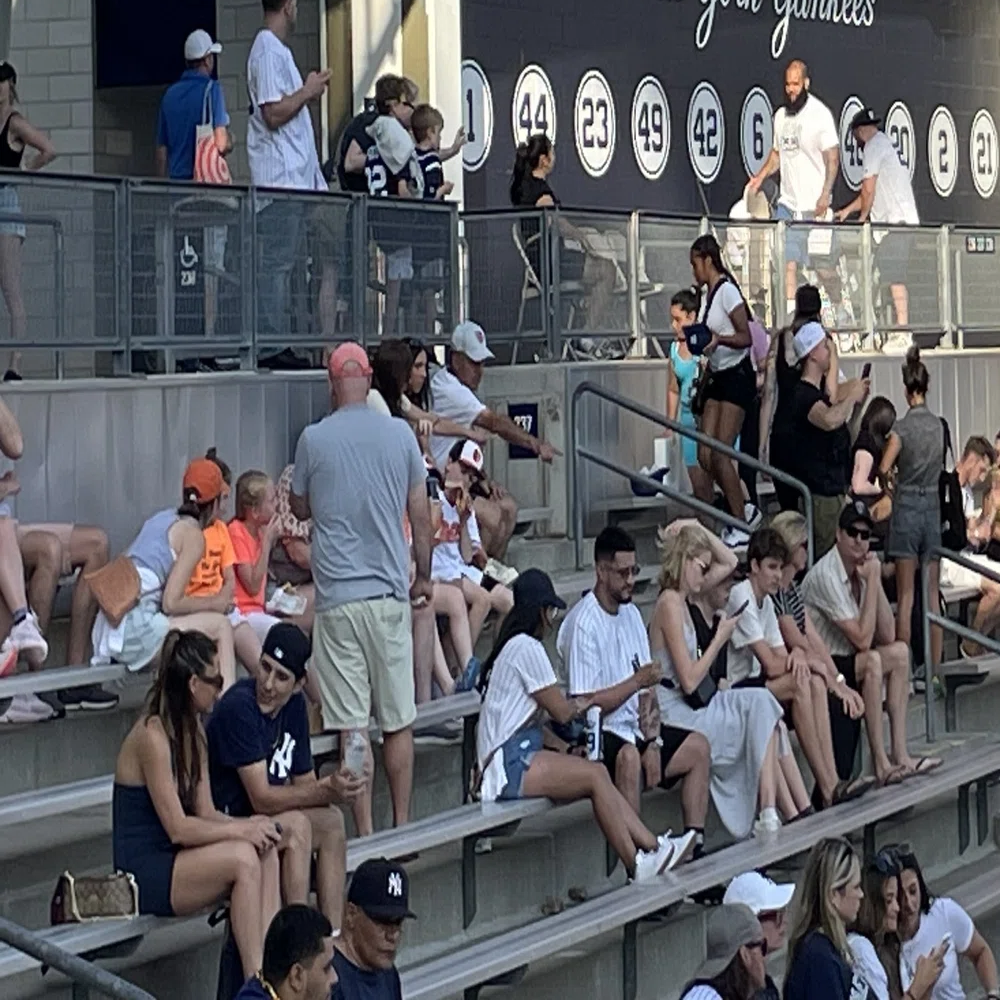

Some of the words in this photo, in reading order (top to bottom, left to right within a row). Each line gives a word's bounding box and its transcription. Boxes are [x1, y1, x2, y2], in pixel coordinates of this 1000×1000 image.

[466, 89, 475, 142] 1
[519, 92, 548, 137] 44
[582, 97, 608, 149] 23
[638, 102, 663, 152] 49
[693, 108, 718, 156] 42
[753, 113, 764, 160] 6
[938, 130, 949, 173] 2
[976, 132, 993, 174] 21
[269, 732, 296, 779] NY
[388, 872, 402, 896] NY
